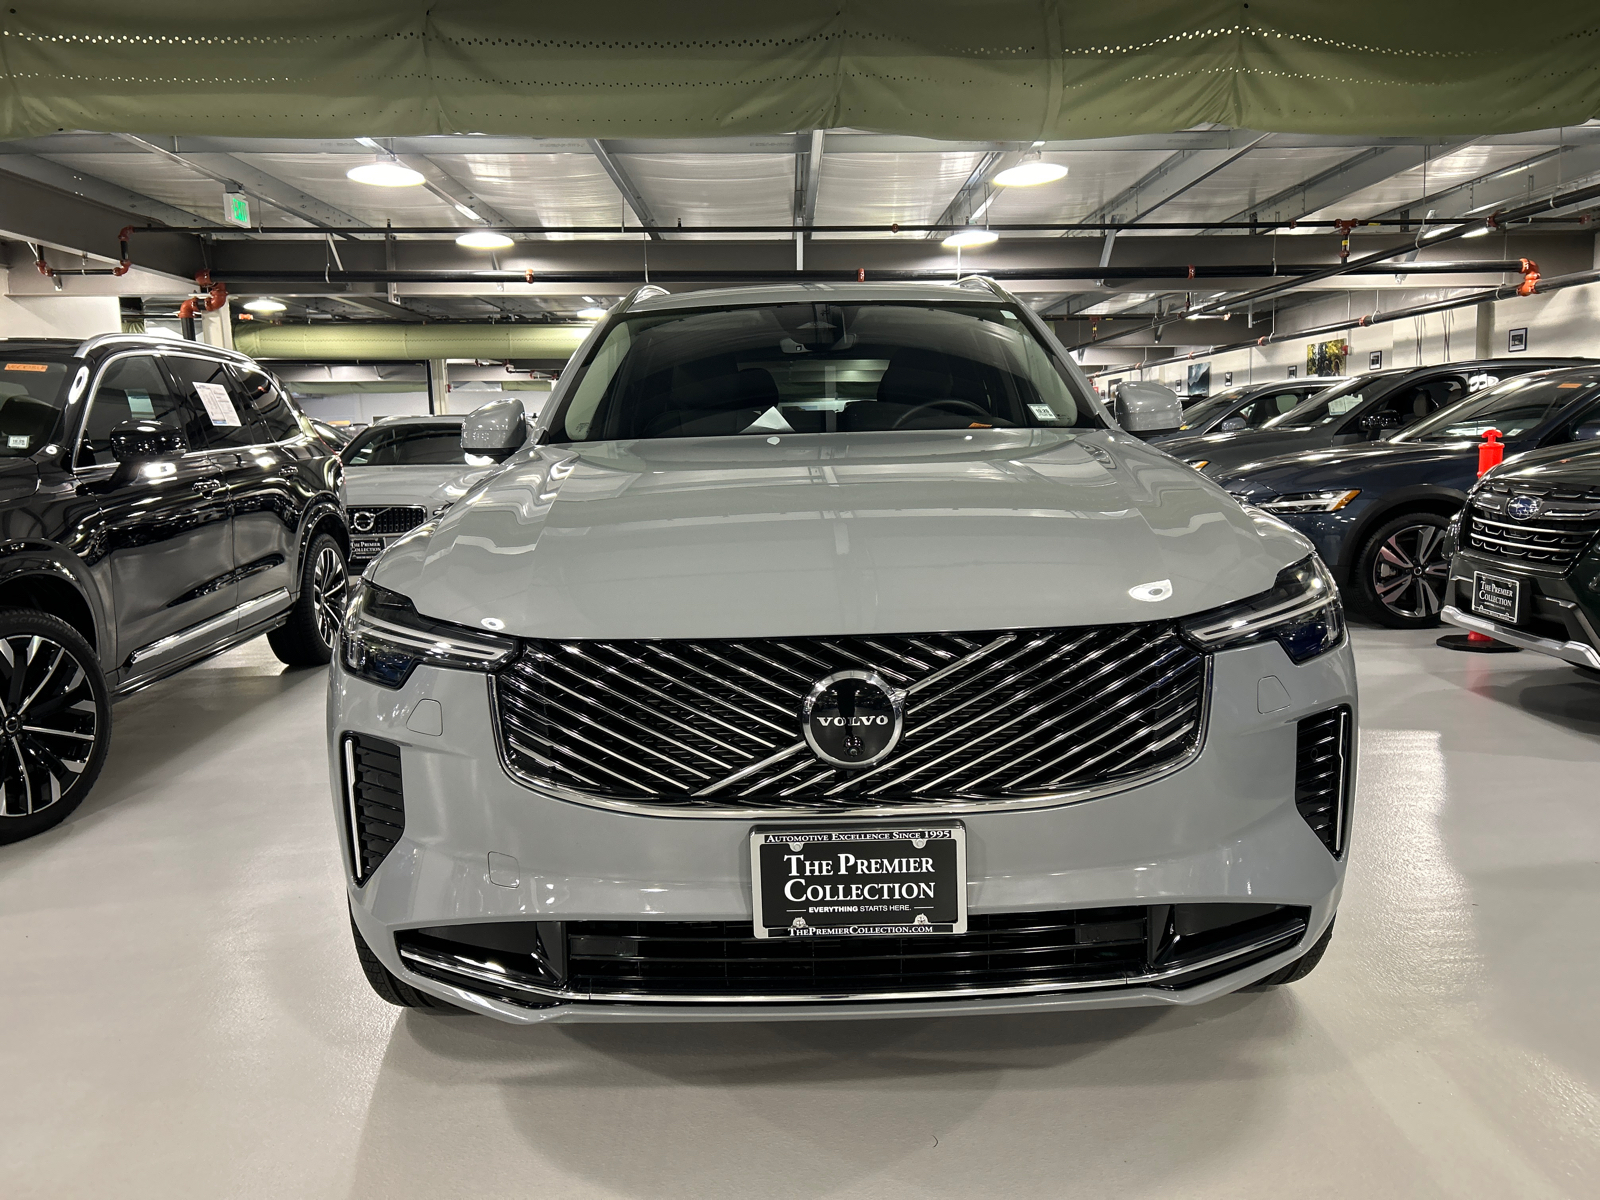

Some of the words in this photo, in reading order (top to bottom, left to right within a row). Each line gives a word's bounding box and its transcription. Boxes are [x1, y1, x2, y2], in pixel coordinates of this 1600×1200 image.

[1480, 581, 1492, 592] THE
[1491, 583, 1513, 597] PREMIER
[1479, 590, 1513, 607] COLLECTION
[816, 715, 889, 727] VOLVO
[766, 834, 830, 843] AUTOMOTIVE
[831, 833, 890, 841] EXCELLENCE
[892, 831, 921, 840] SINCE
[924, 830, 950, 839] 1995
[783, 854, 834, 876] THE
[837, 853, 936, 875] PREMIER
[784, 878, 936, 902] COLLECTION
[808, 905, 859, 913] EVERYTHING
[788, 925, 933, 936] THEPREMIERCOLLECTION.COM
